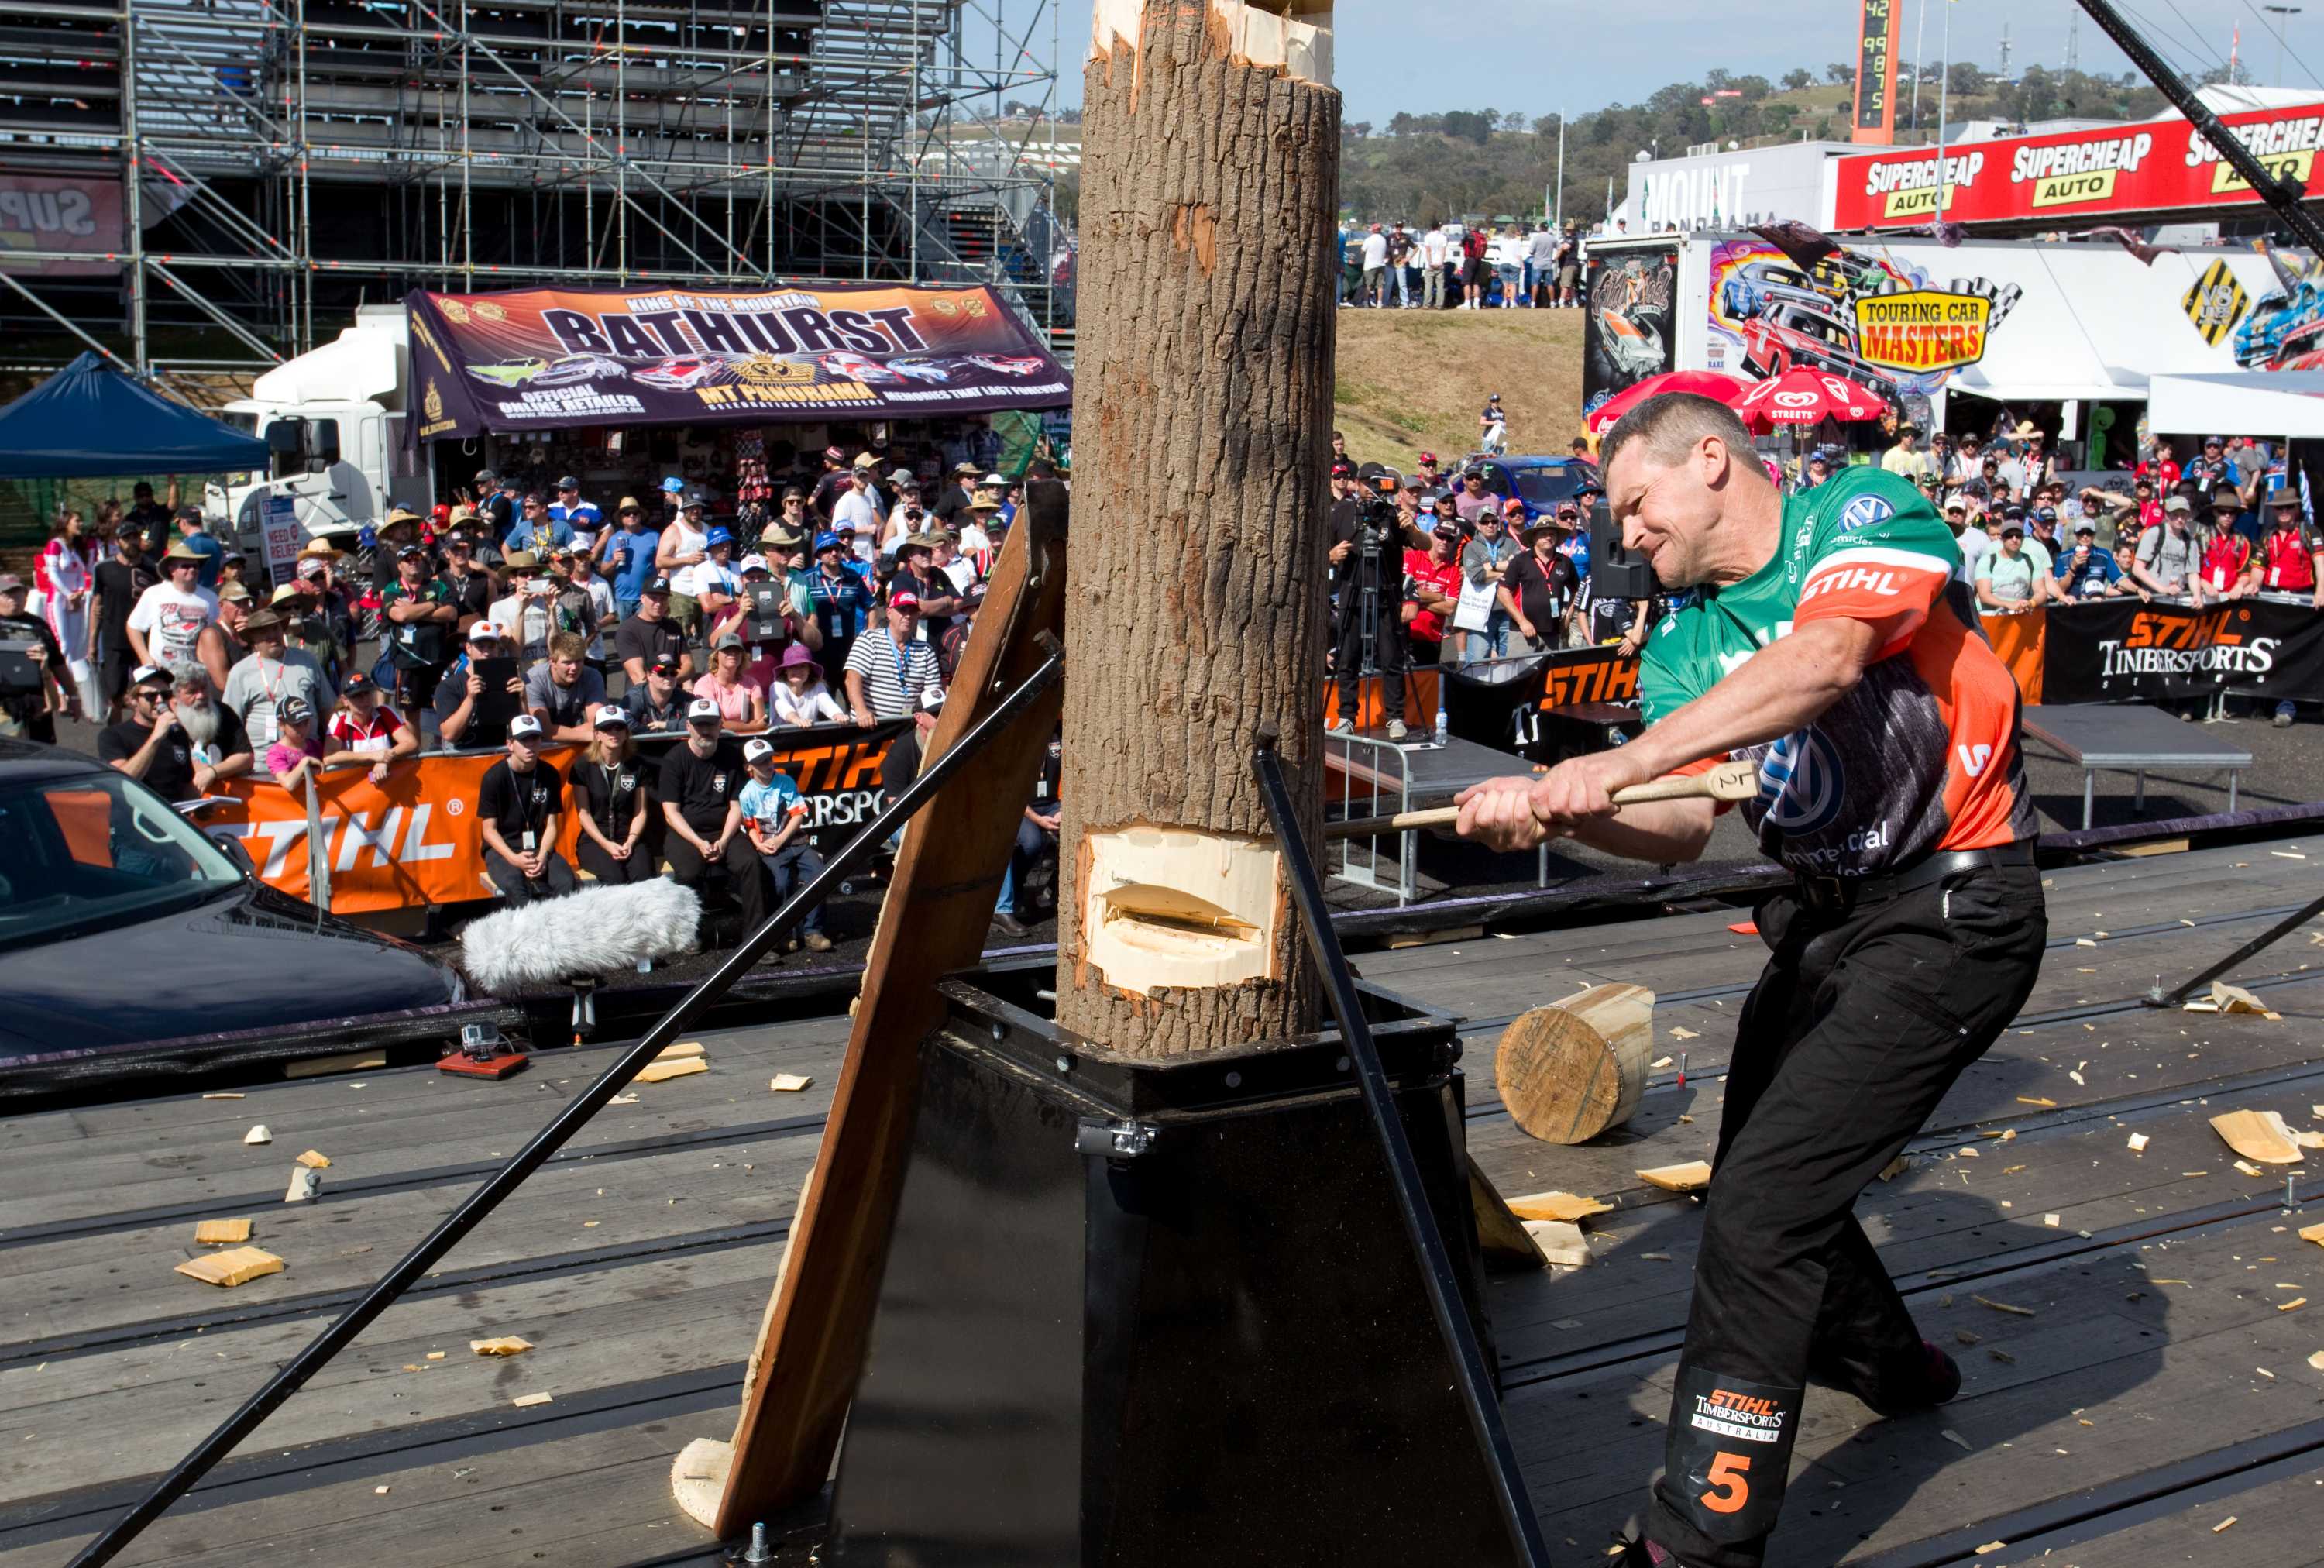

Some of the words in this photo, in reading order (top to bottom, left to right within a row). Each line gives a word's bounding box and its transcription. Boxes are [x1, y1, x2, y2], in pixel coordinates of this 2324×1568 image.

[1864, 36, 1887, 54] 99
[1874, 55, 1886, 73] 8
[1875, 74, 1885, 90] 7
[1872, 91, 1883, 110] 5
[2010, 132, 2152, 184] SUPERCHEAP
[2225, 159, 2299, 184] ATO
[1646, 163, 1750, 230] MOUNT
[2044, 177, 2105, 199] AUTO
[1651, 211, 1776, 233] PNORAMA
[626, 297, 674, 312] KING
[675, 294, 697, 309] OF
[696, 297, 730, 311] THE
[731, 292, 822, 311] MOUNTAIN
[1866, 303, 1941, 323] TOURING
[1947, 302, 1979, 322] CAR
[540, 306, 930, 359] BATHURST
[1865, 325, 1979, 365] MASTERS
[498, 401, 562, 414] ONLINE
[561, 394, 641, 411] RETAILER
[521, 383, 599, 404] OFFICIAL
[695, 384, 739, 406] MT
[739, 381, 878, 404] PANORAMA
[707, 399, 800, 411] CELEBRATING
[801, 400, 827, 409] THE
[828, 398, 885, 408] WINNERS
[882, 390, 952, 402] MEMORIES
[950, 386, 983, 400] THAT
[980, 384, 1012, 396] LAST
[1772, 409, 1813, 420] STREETS
[1801, 568, 1900, 607] STIHL
[2125, 609, 2243, 649] STIHL
[2099, 636, 2275, 676] TIMBERSPORTS
[1540, 657, 1641, 710] STIH
[771, 738, 896, 793] STIH
[205, 803, 456, 879] TIHL
[1695, 1394, 1785, 1429] TIMBERSPORTS
[1708, 1388, 1773, 1416] STIHL
[1697, 1417, 1776, 1441] AUSTRALIA
[1700, 1450, 1752, 1514] 5
